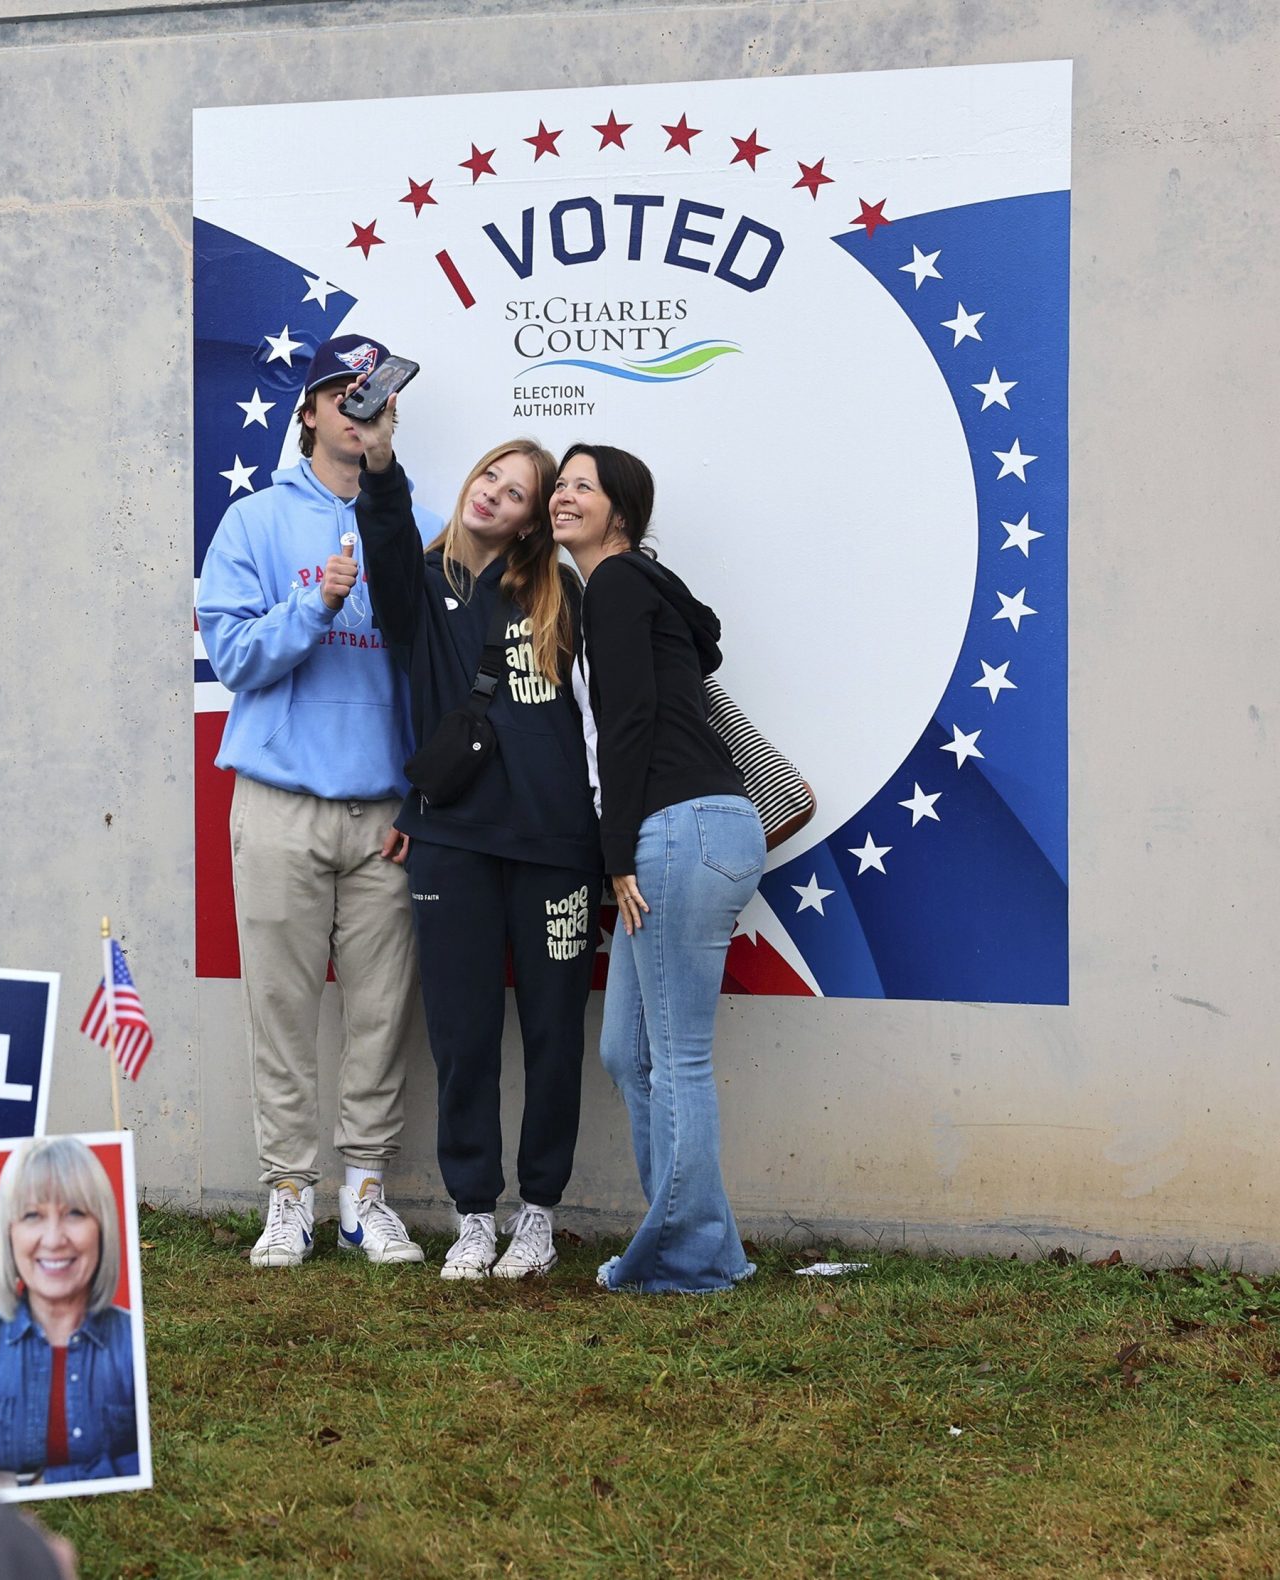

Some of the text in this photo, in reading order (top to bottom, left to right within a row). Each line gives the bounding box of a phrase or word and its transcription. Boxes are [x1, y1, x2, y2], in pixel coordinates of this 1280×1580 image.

[435, 193, 785, 309] I VOTED
[513, 323, 677, 359] COUNTY
[513, 385, 585, 400] ELECTION
[512, 402, 596, 417] AUTHORITY
[504, 617, 534, 640] ho
[505, 642, 535, 672] an
[545, 885, 589, 916] hope
[546, 911, 577, 939] and
[546, 936, 588, 961] future
